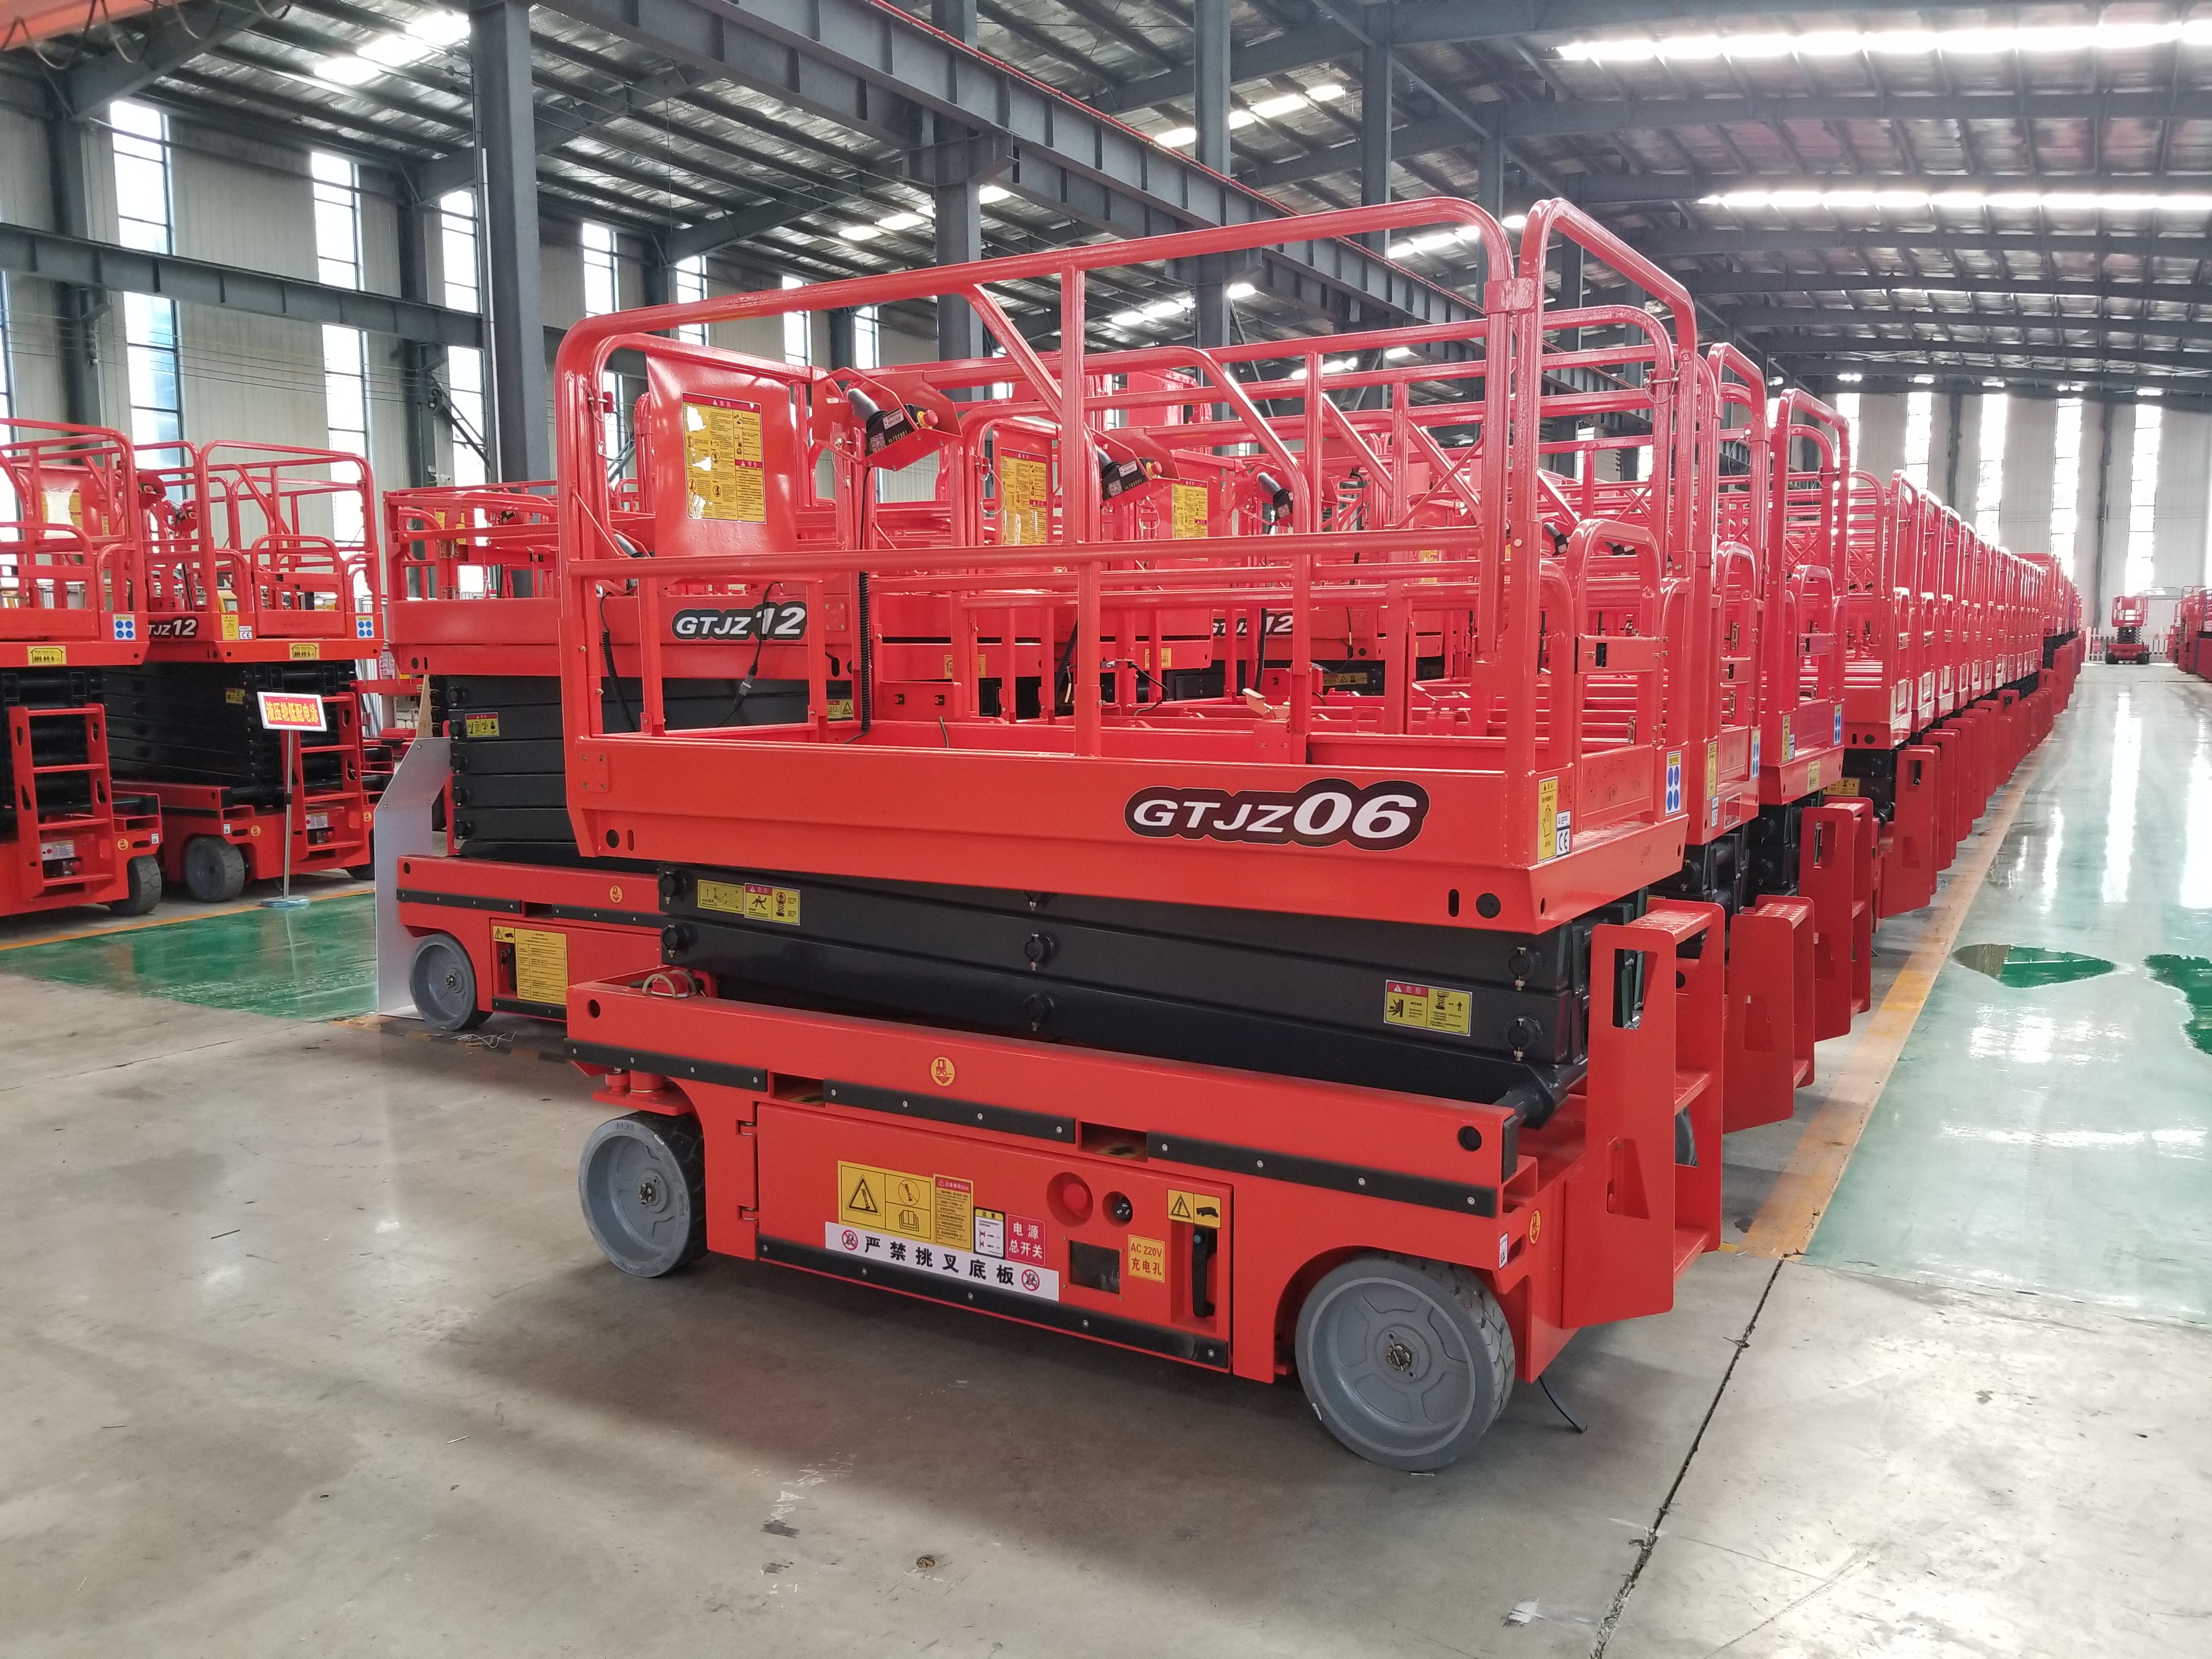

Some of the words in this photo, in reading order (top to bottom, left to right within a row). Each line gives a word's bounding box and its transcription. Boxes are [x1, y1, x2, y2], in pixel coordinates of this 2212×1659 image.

[148, 619, 197, 635] TJZ12
[676, 607, 806, 635] GTJZ12
[1133, 792, 1418, 838] GTJZ06
[1406, 985, 1422, 995] 危险
[1013, 1221, 1039, 1240] 电源
[1009, 1239, 1043, 1259] 总开关
[1131, 1243, 1142, 1253] AC
[1143, 1245, 1163, 1257] 220V
[864, 1235, 1015, 1286] 严禁挑叉底板
[1131, 1257, 1162, 1276] 充电孔
